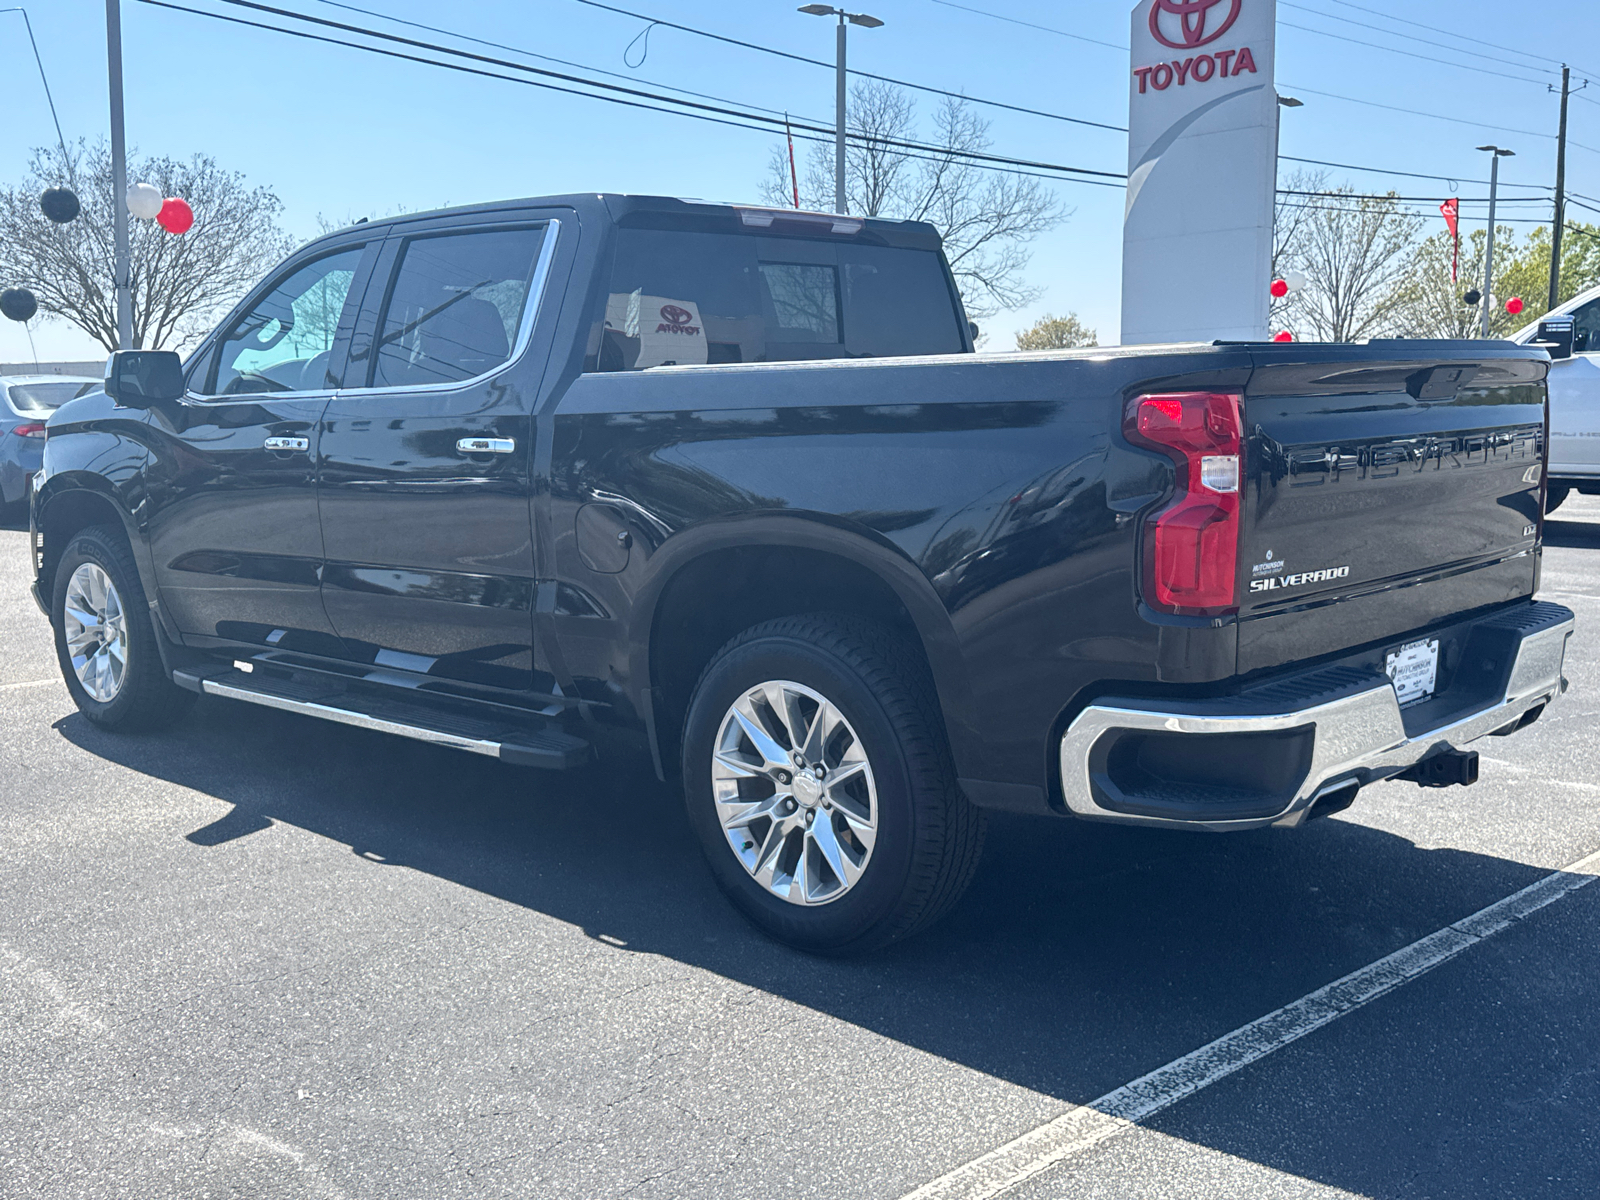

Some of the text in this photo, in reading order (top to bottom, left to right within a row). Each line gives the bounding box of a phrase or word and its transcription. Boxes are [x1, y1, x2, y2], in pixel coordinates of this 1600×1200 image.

[1133, 47, 1257, 94] TOYOTA
[1287, 427, 1541, 488] CHEVROLET
[81, 543, 120, 586] COOPER
[1249, 566, 1350, 593] SILVERADO
[1252, 560, 1285, 572] HUTCHINSON
